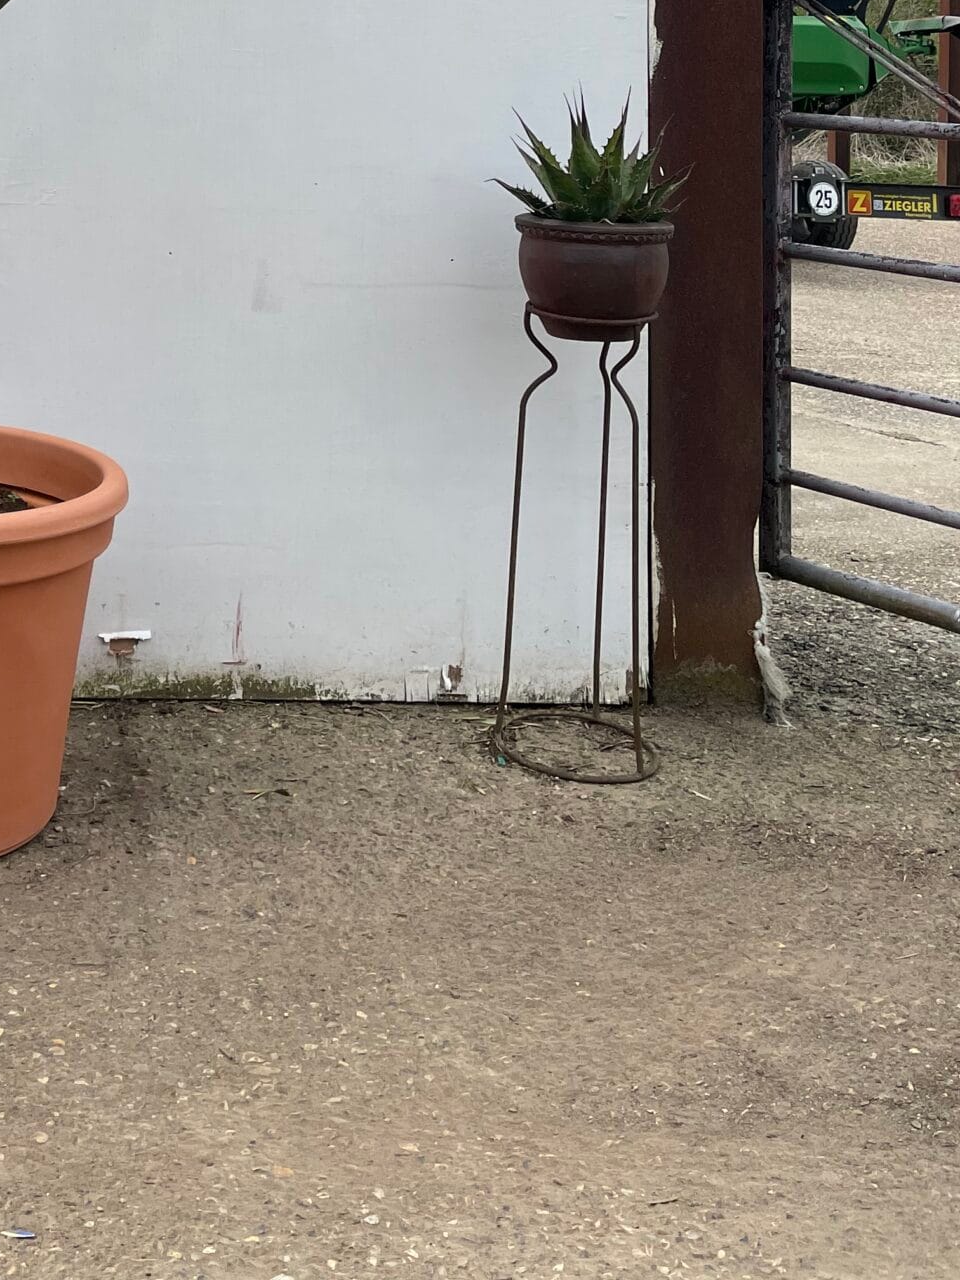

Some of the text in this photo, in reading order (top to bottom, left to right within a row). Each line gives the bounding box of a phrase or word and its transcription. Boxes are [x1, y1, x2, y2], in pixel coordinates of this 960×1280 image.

[815, 190, 833, 209] 25
[852, 193, 867, 212] Z
[883, 200, 932, 213] ZIEGLER
